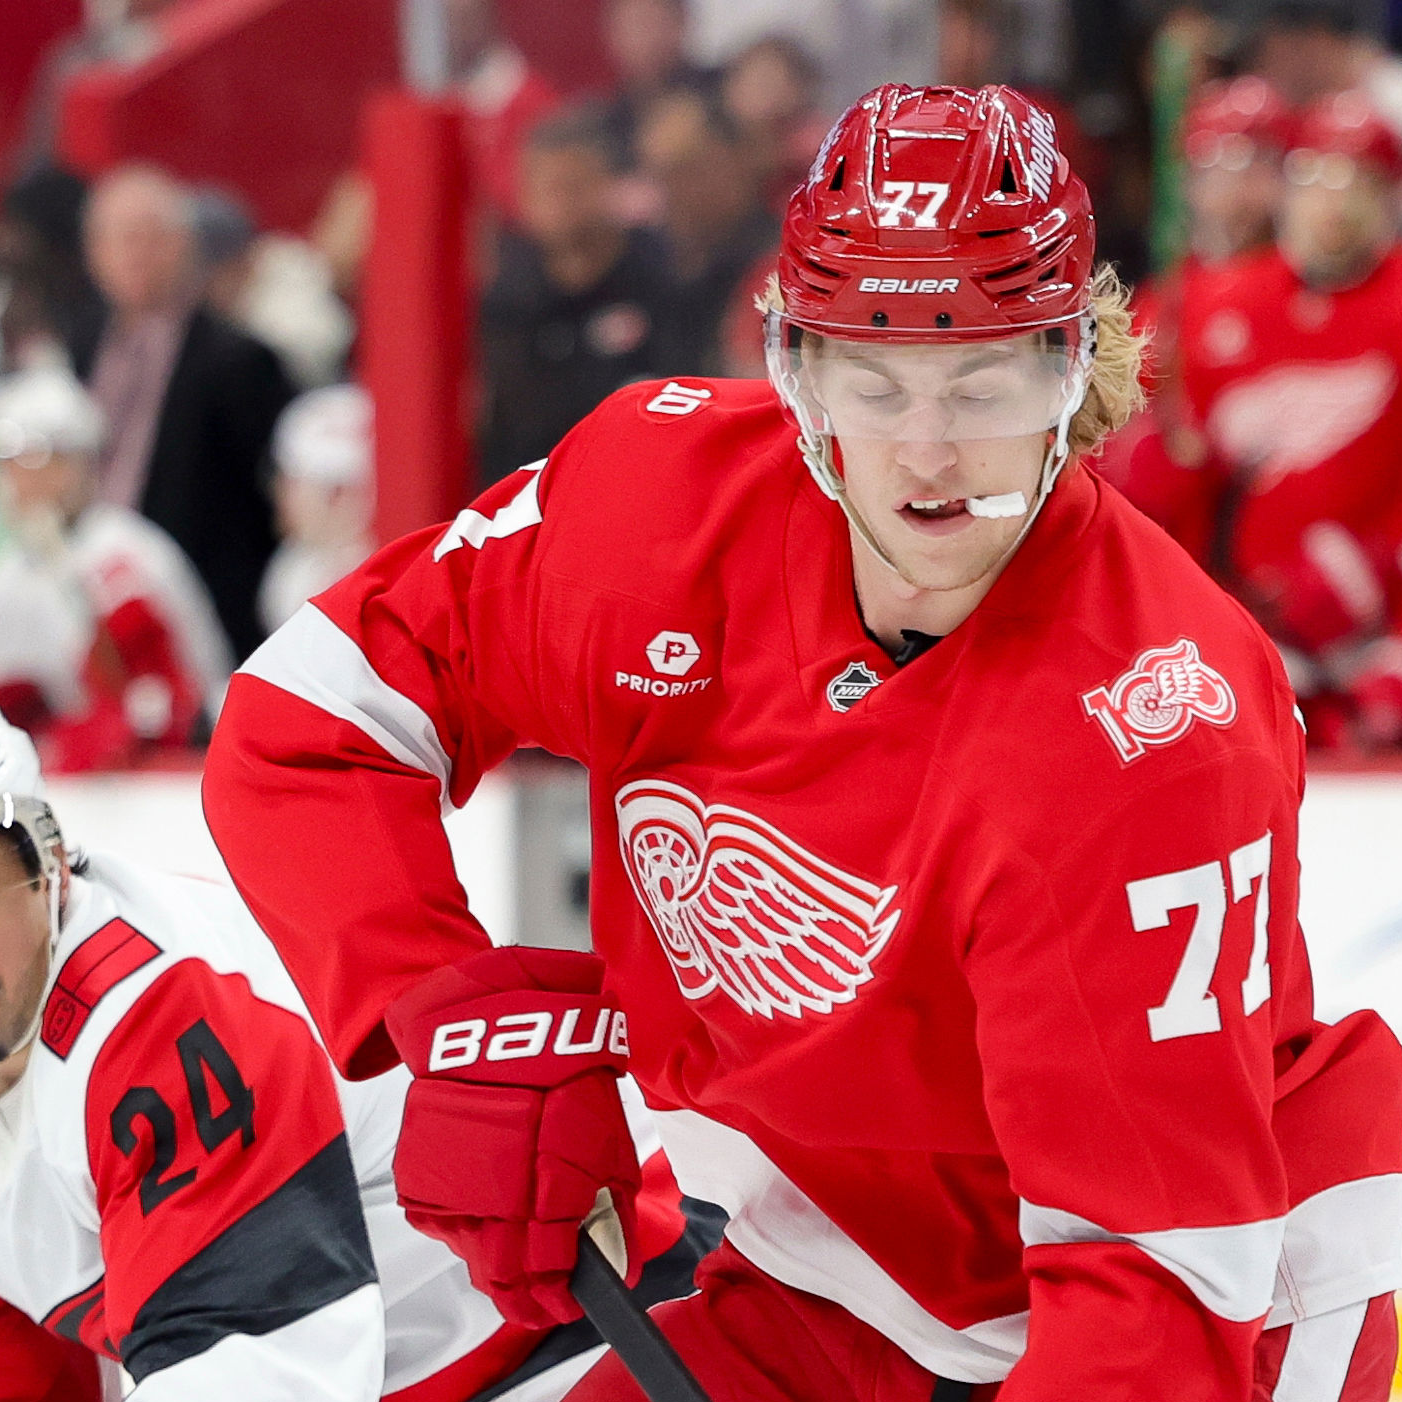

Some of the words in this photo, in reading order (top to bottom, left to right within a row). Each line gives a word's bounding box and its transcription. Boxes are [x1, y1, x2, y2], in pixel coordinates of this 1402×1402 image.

[878, 180, 951, 228] 77
[858, 277, 960, 294] BAUER
[615, 671, 712, 697] PRIORITY
[1125, 829, 1273, 1043] 77
[110, 1016, 257, 1219] 24
